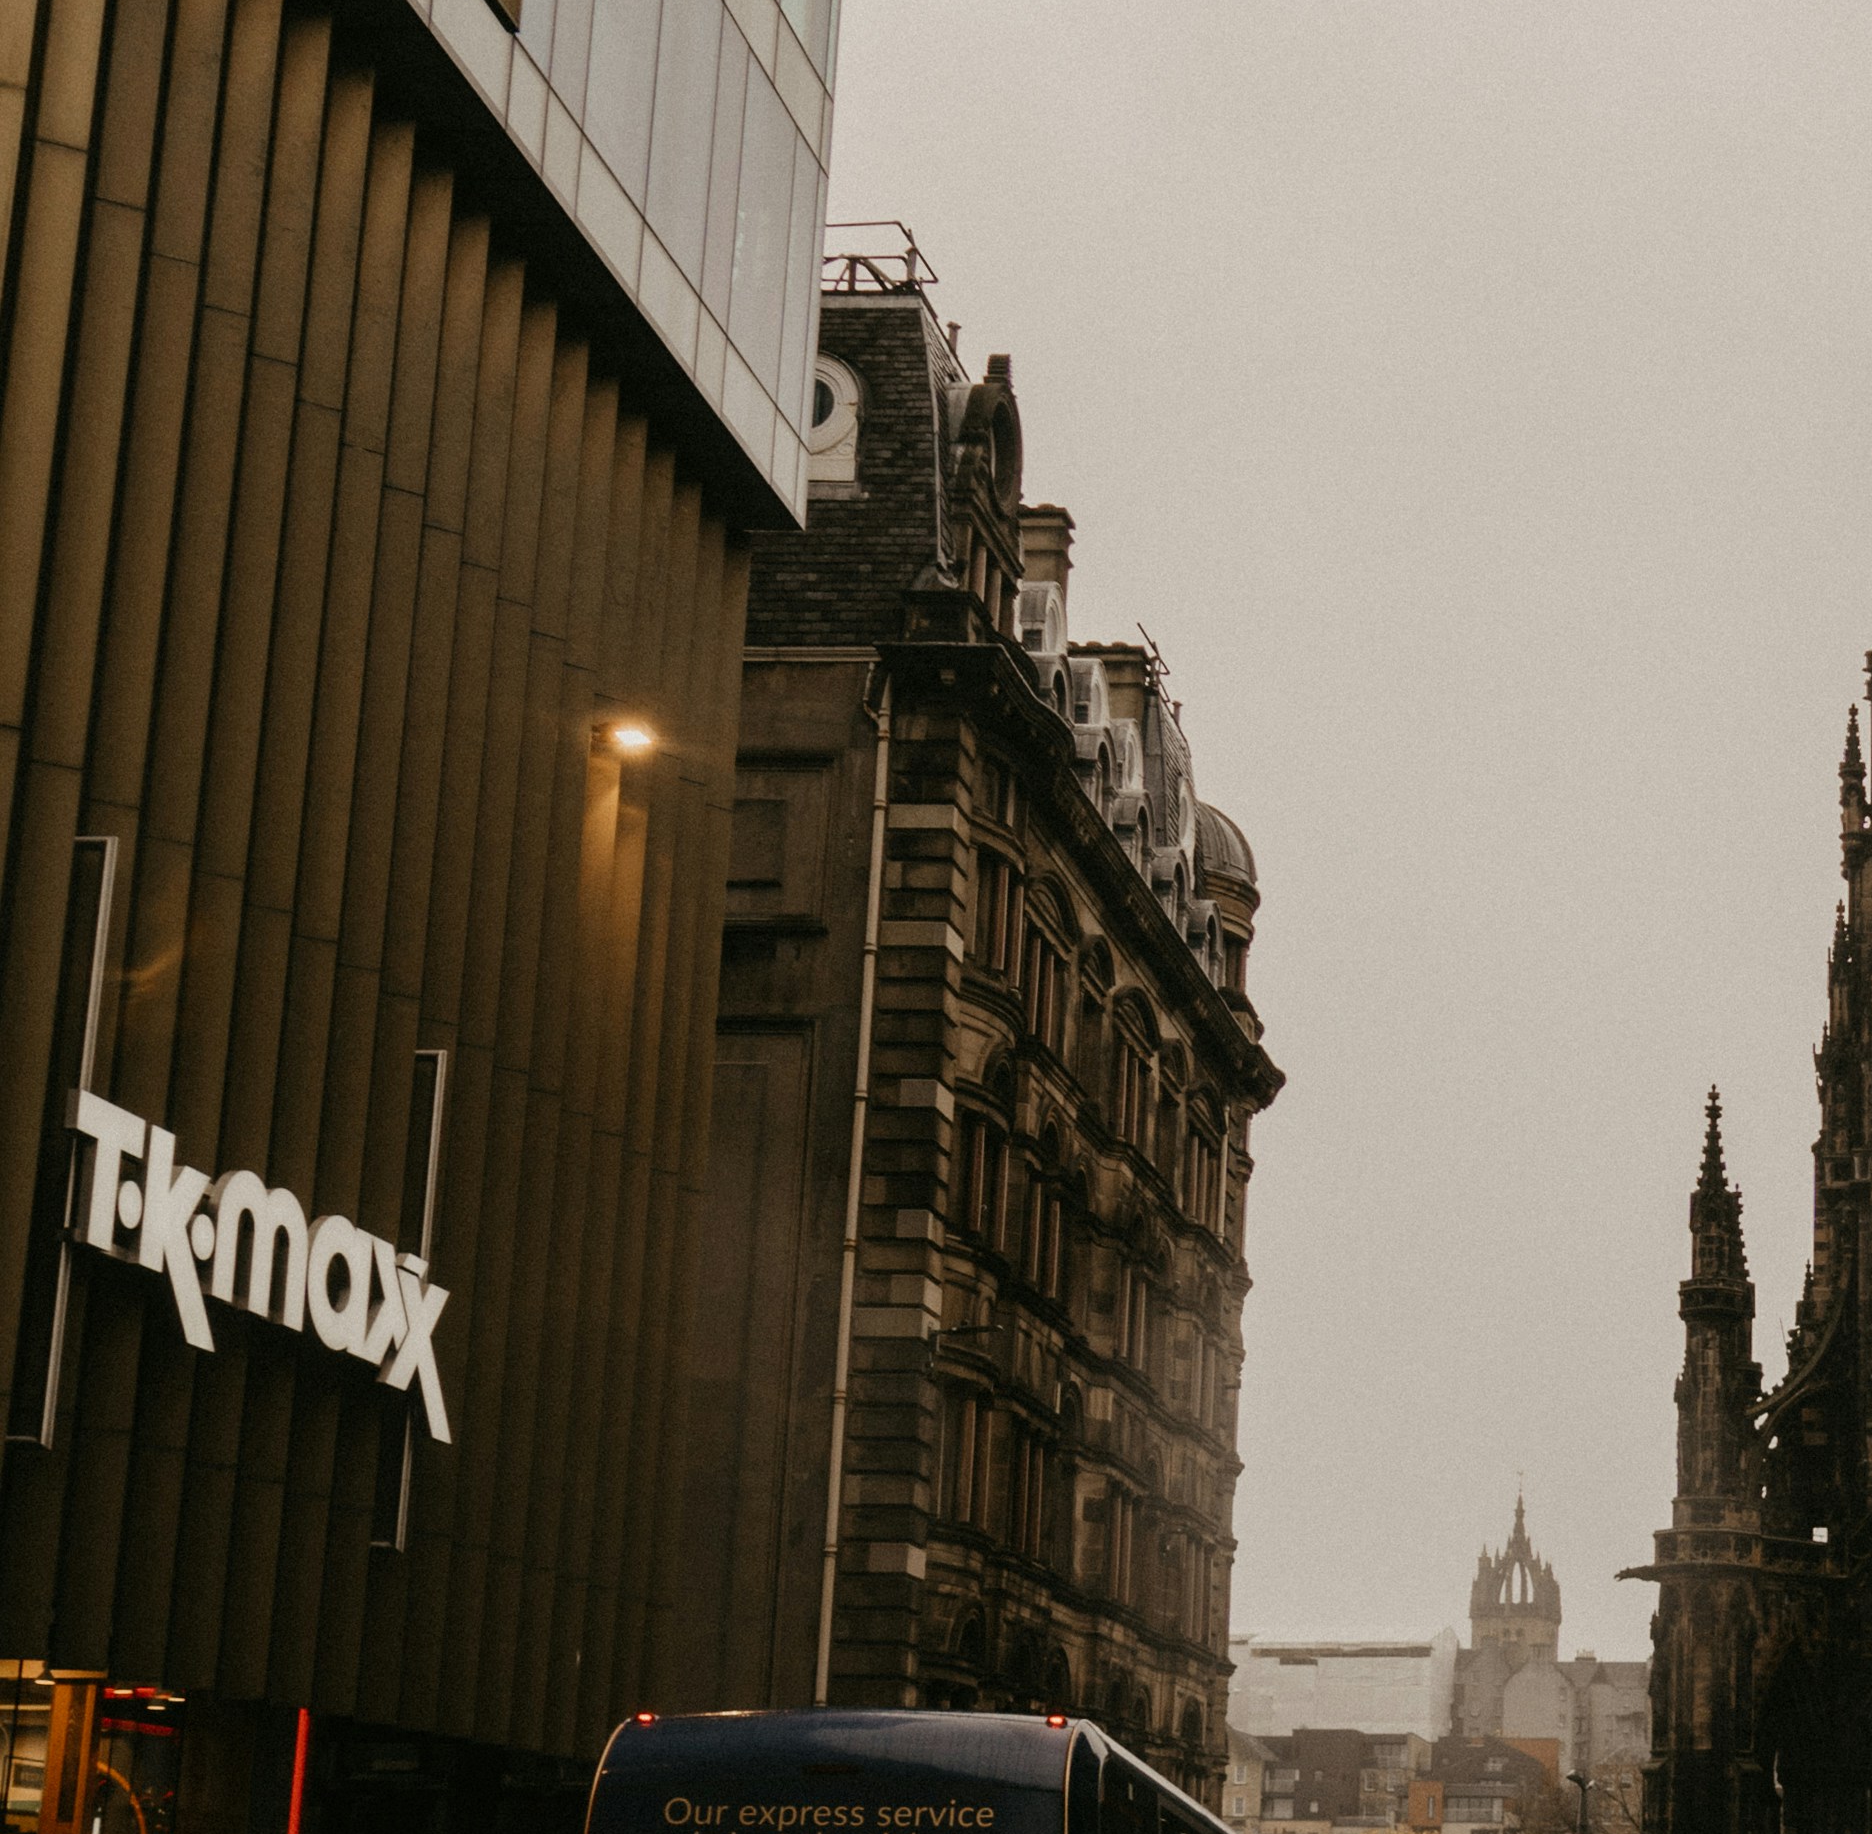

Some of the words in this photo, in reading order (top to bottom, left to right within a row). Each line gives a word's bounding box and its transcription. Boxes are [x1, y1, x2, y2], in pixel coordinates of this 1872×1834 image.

[663, 1796, 729, 1826] Our
[738, 1801, 866, 1832] express
[876, 1799, 995, 1829] service
